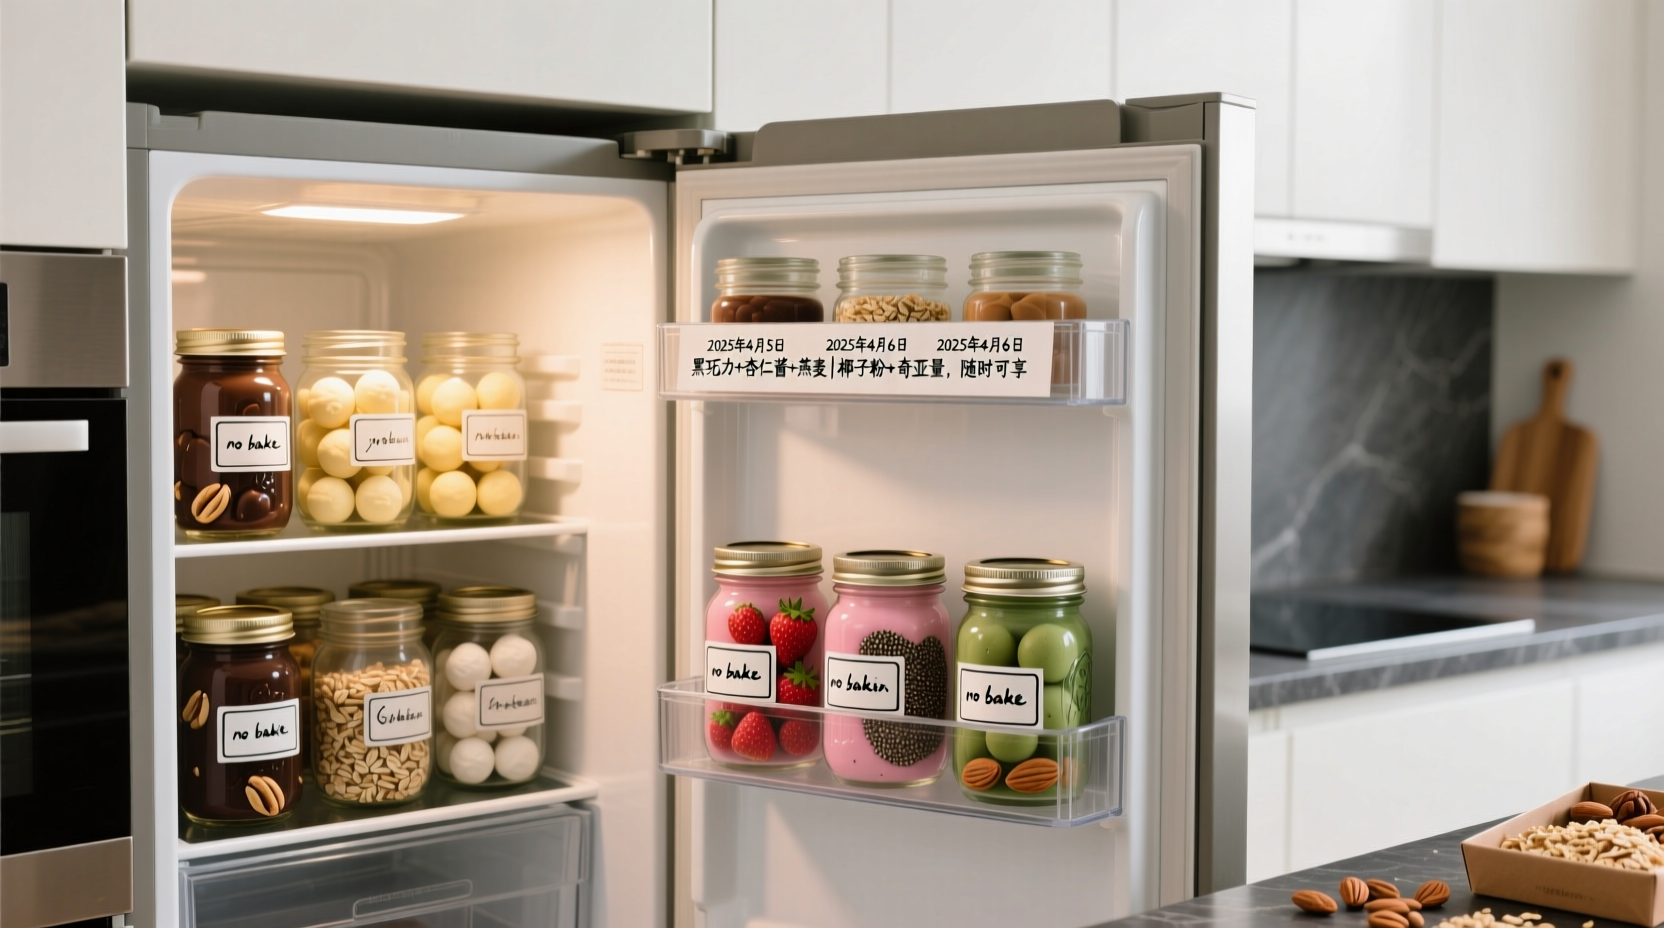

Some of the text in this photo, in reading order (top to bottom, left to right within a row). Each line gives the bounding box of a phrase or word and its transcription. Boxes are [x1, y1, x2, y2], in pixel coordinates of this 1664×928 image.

[707, 336, 1023, 353] 2025年4月5日 2025年4月6日 2025年4月6日
[226, 433, 281, 451] no bake
[726, 662, 762, 680] bake
[830, 678, 843, 689] no
[966, 684, 1027, 706] no bake
[232, 721, 289, 741] no bake
